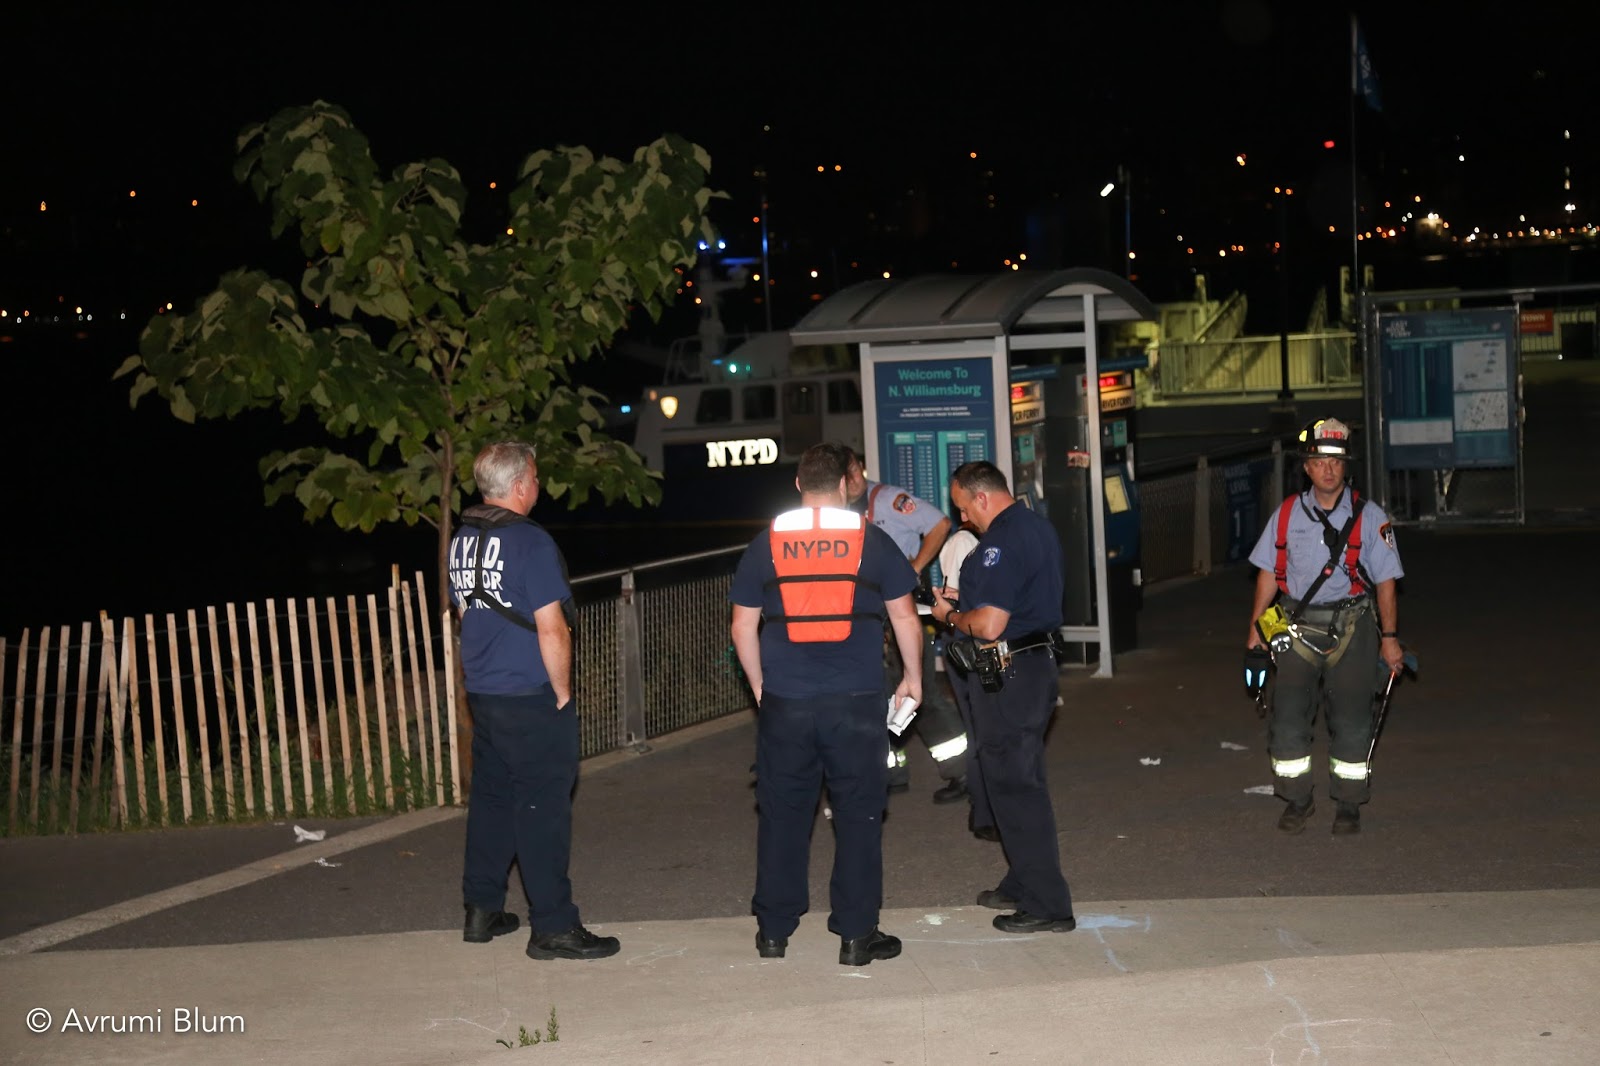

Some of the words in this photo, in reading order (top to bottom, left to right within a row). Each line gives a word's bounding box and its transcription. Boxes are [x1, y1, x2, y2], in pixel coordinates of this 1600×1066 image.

[898, 369, 952, 380] Welcome
[954, 366, 968, 379] To
[888, 385, 902, 397] N.
[903, 384, 982, 397] Williamsburg
[706, 438, 779, 468] NYPD
[783, 540, 849, 560] NYPD
